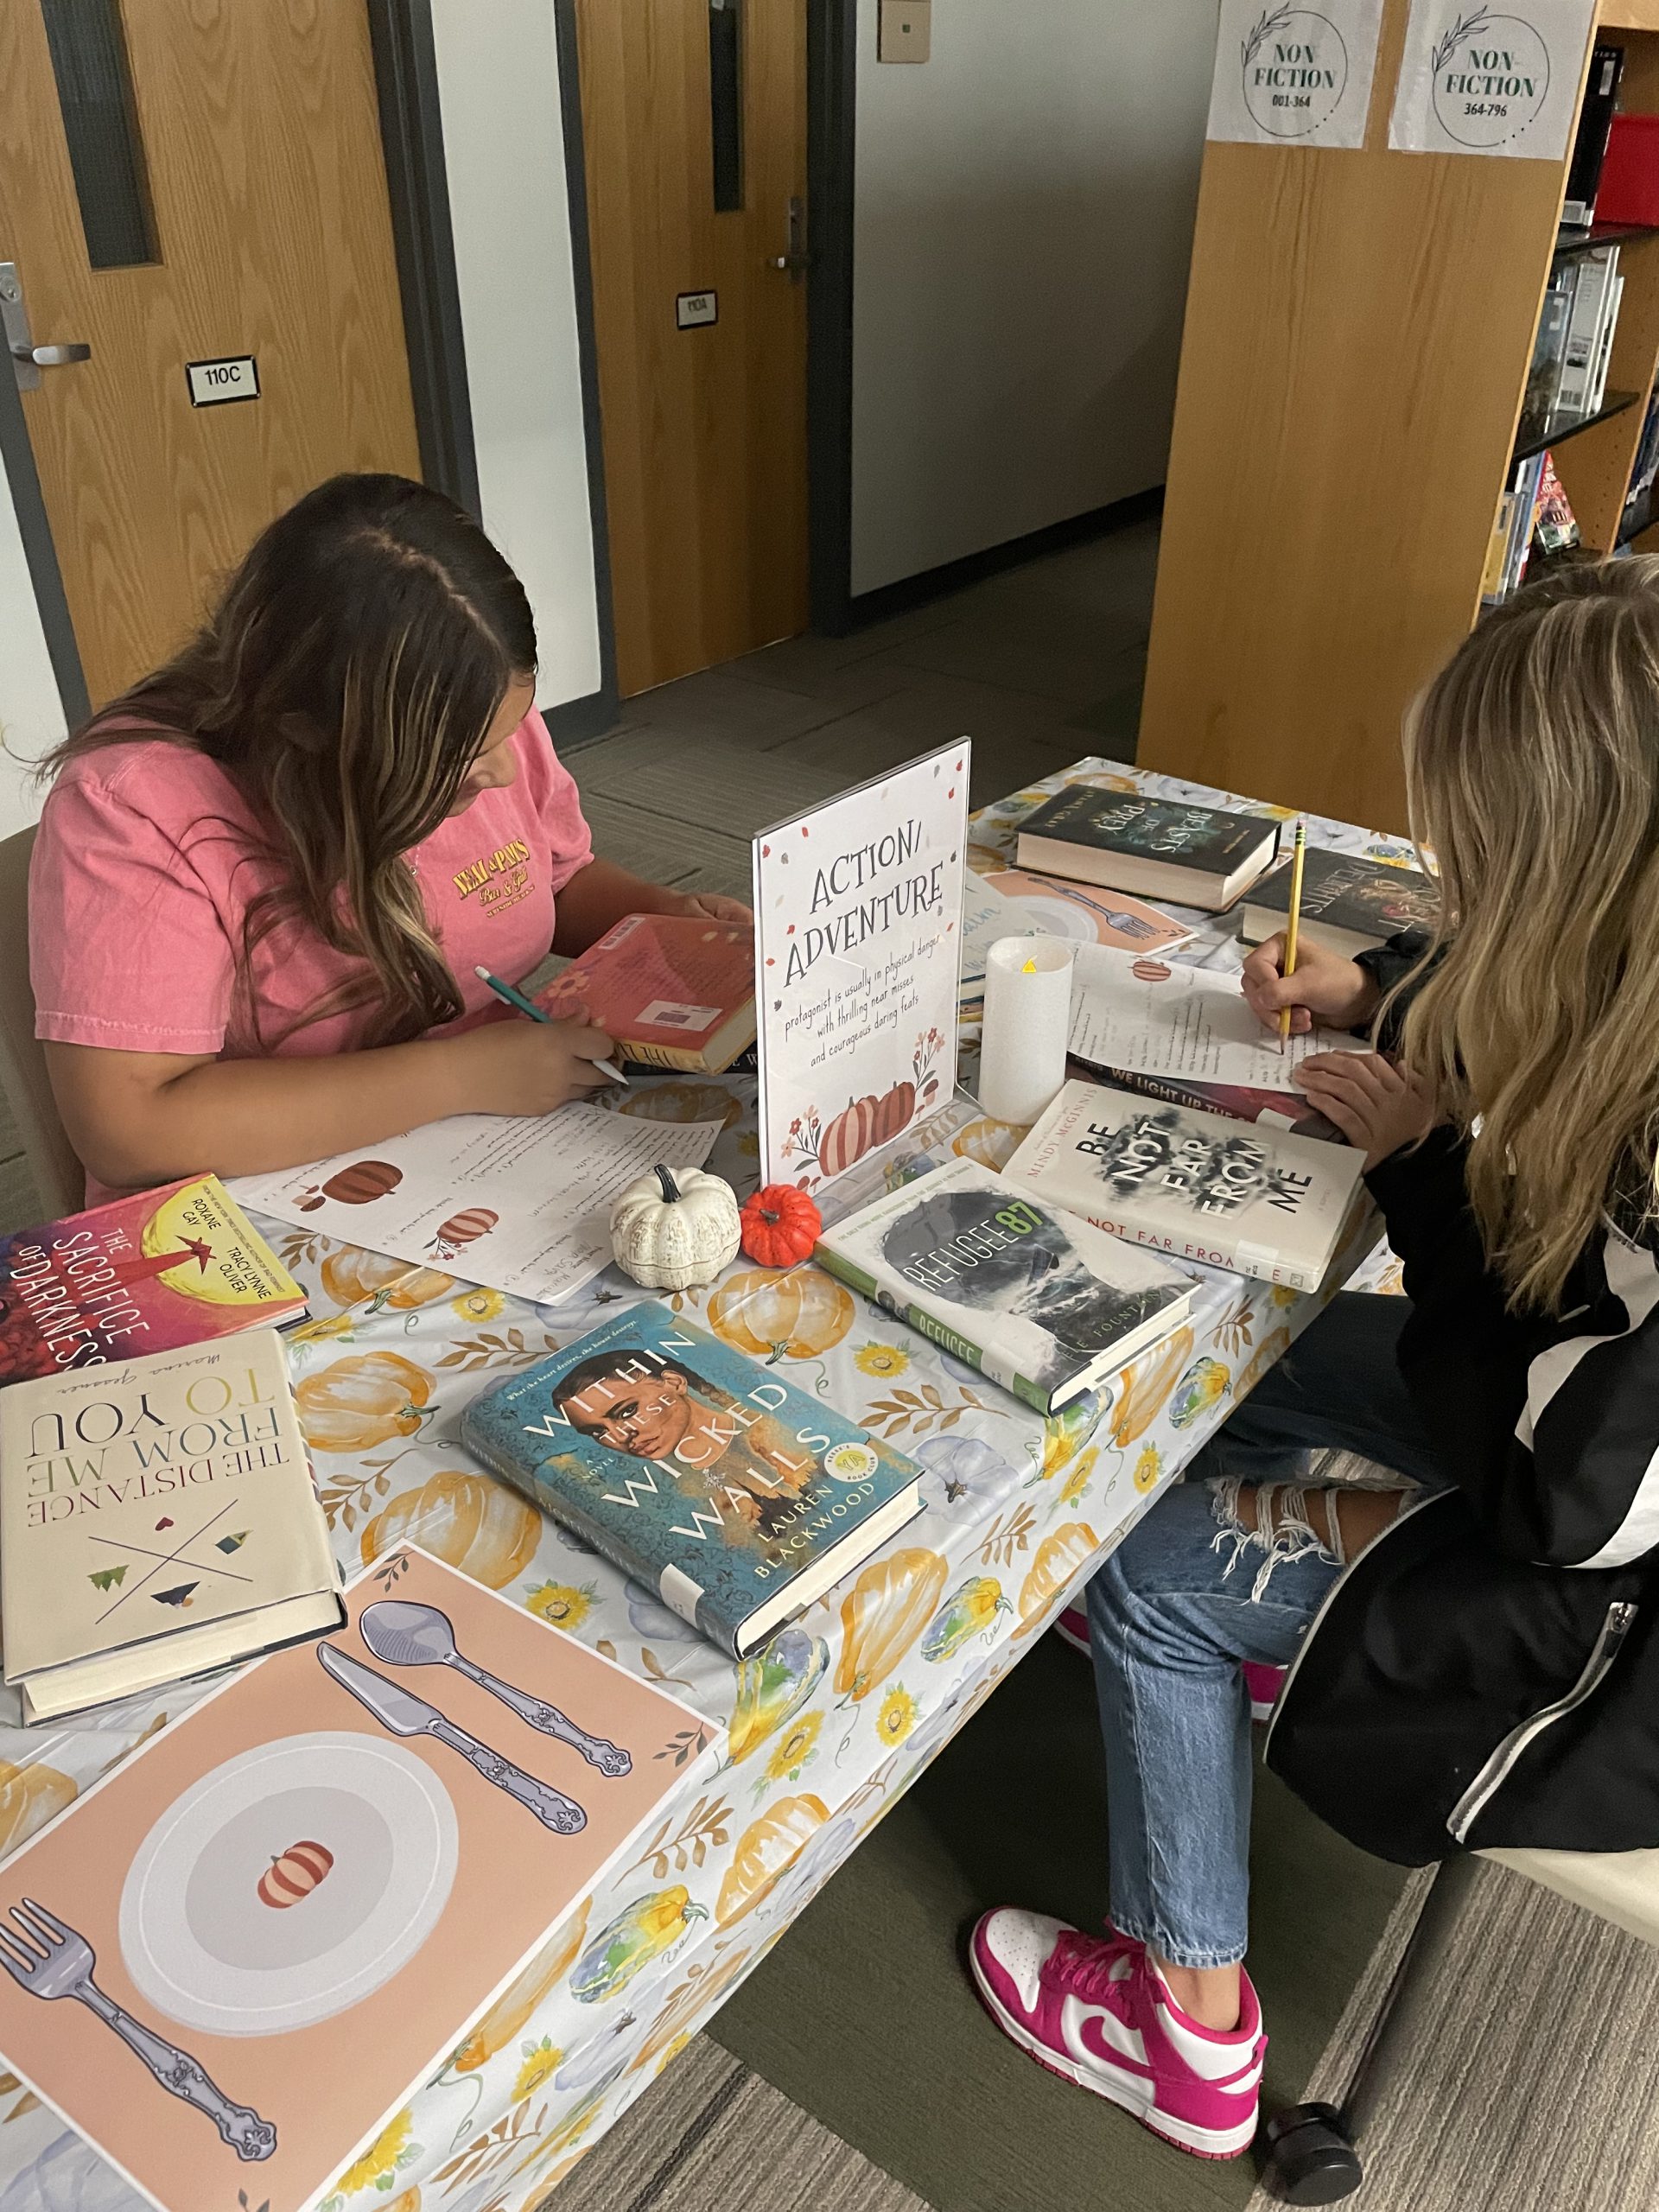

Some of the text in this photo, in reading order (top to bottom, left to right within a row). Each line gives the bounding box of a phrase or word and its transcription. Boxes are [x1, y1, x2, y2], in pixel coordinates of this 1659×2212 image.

[1254, 67, 1335, 89] FICTION
[1272, 93, 1311, 107] 001-364
[1446, 73, 1538, 98] FICTION
[1465, 103, 1507, 117] 364-796
[205, 365, 240, 385] 110C
[1100, 804, 1146, 836] PREY
[1150, 810, 1213, 854] BEASTS
[810, 819, 922, 915] ACTION/
[784, 860, 944, 988] ADVENTURE
[785, 988, 831, 1042] protagonist
[835, 992, 842, 1004] is
[844, 968, 872, 996] usually
[874, 970, 881, 982] in
[885, 941, 915, 986] physical
[917, 934, 940, 958] danger
[817, 975, 914, 1038] with thrilling near misses
[810, 988, 919, 1067] and courageous daring feats
[1110, 1067, 1134, 1084] WE
[1136, 1077, 1179, 1103] LIGHT
[1181, 1093, 1202, 1109] UP
[1027, 1144, 1058, 1178] MINDY
[1056, 1087, 1098, 1138] McGINNIS
[1075, 1122, 1120, 1157] BE
[1111, 1121, 1171, 1183] NOT
[1160, 1138, 1211, 1192] FAR
[1200, 1138, 1266, 1220] FROM
[1267, 1167, 1313, 1214] ME
[182, 1211, 201, 1226] GAY
[192, 1198, 221, 1230] ROXANE
[1086, 1216, 1128, 1237] NOT
[1137, 1230, 1173, 1250] FAR
[18, 1245, 48, 1268] OF
[100, 1227, 133, 1255] THE
[902, 1219, 1020, 1292] REFUGEE
[994, 1201, 1045, 1235] 87
[53, 1231, 150, 1345] SACRIFICE
[219, 1263, 248, 1294] OLIVER
[226, 1246, 272, 1300] TRACY LYNNE
[918, 1314, 976, 1366] REFUGEE
[1093, 1289, 1160, 1338] FOUNTAIN
[149, 1353, 220, 1376] Marina
[506, 1387, 526, 1402] What
[527, 1381, 538, 1390] the
[537, 1370, 557, 1382] heart
[556, 1354, 583, 1372] desires,
[582, 1346, 593, 1356] the
[591, 1335, 612, 1349] house
[522, 1331, 696, 1440] WITHIN
[24, 1367, 275, 1460] TO YOU
[131, 1406, 284, 1471] FROM
[598, 1392, 677, 1445] THESE
[27, 1446, 108, 1499] ME
[222, 1442, 290, 1478] THE
[601, 1382, 788, 1510] WICKED
[836, 1453, 866, 1471] YA
[27, 1458, 215, 1529] DISTANCE
[668, 1426, 832, 1541] WALLS
[753, 1480, 876, 1580] BLACKWOOD
[757, 1484, 835, 1544] LAUREN
